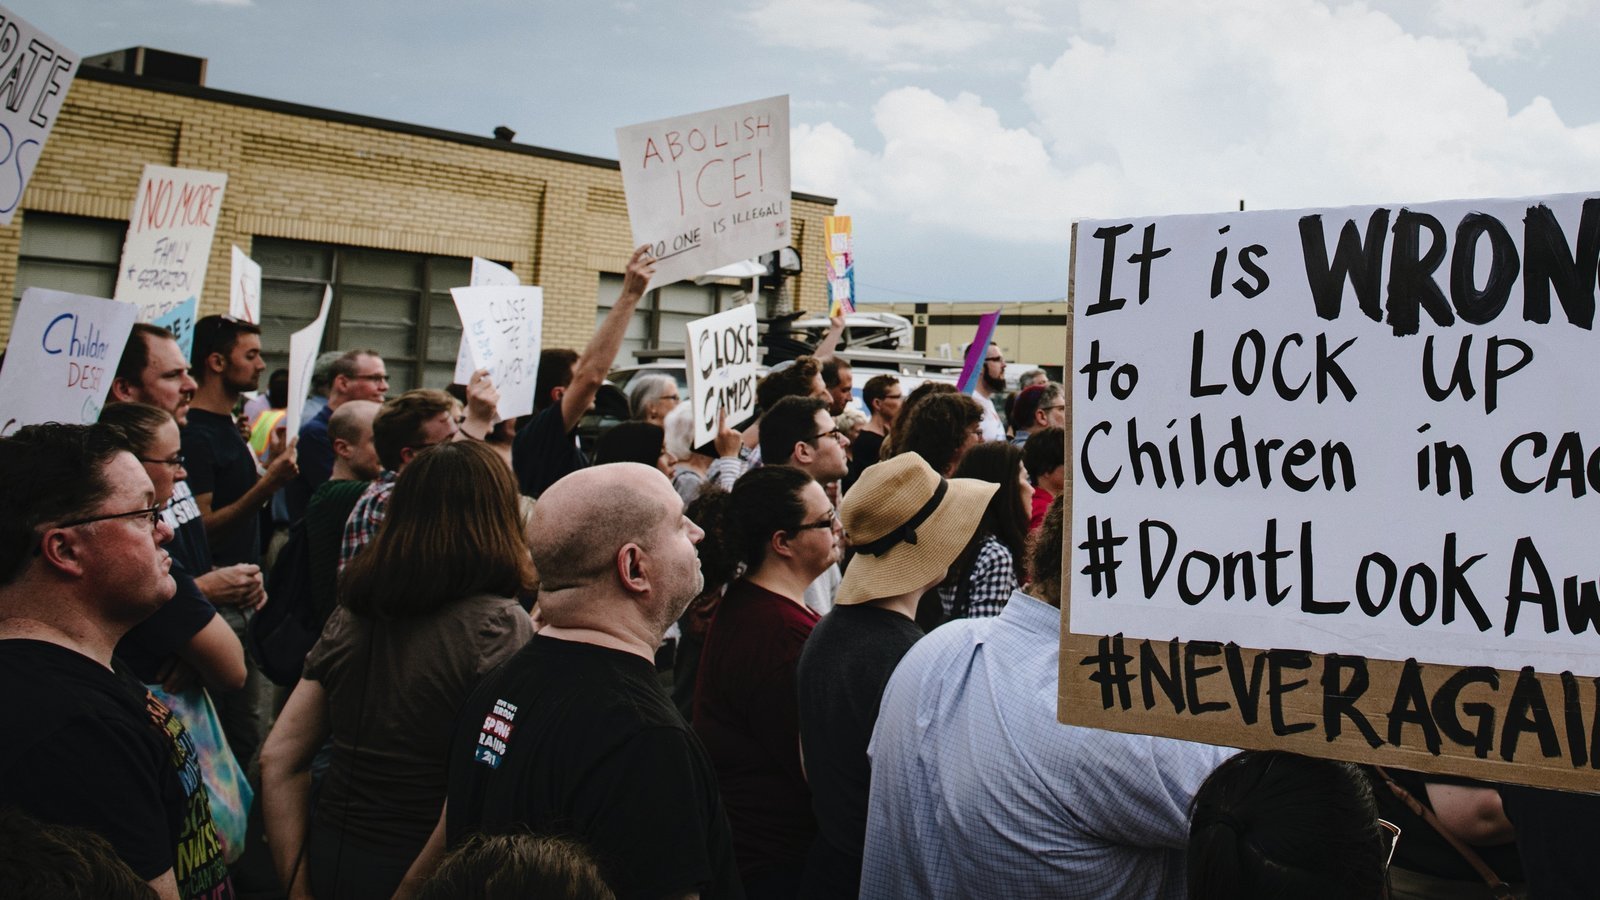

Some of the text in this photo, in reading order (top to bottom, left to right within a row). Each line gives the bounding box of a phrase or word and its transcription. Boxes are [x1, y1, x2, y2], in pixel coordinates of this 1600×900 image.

[642, 115, 771, 169] ABOLISH
[137, 179, 221, 233] NO MORE
[677, 148, 764, 216] ICE!
[673, 227, 701, 250] ONE
[713, 217, 726, 234] IS
[732, 201, 783, 225] ILLEGAL!
[1085, 198, 1600, 337] It is WRON
[699, 324, 755, 380] CLOSE
[1079, 340, 1139, 401] to
[1190, 328, 1358, 404] LOCK
[704, 375, 753, 432] CAMPS
[1080, 413, 1356, 494] Children
[1416, 423, 1473, 500] in
[1079, 632, 1600, 770] #NEVERAGAI
